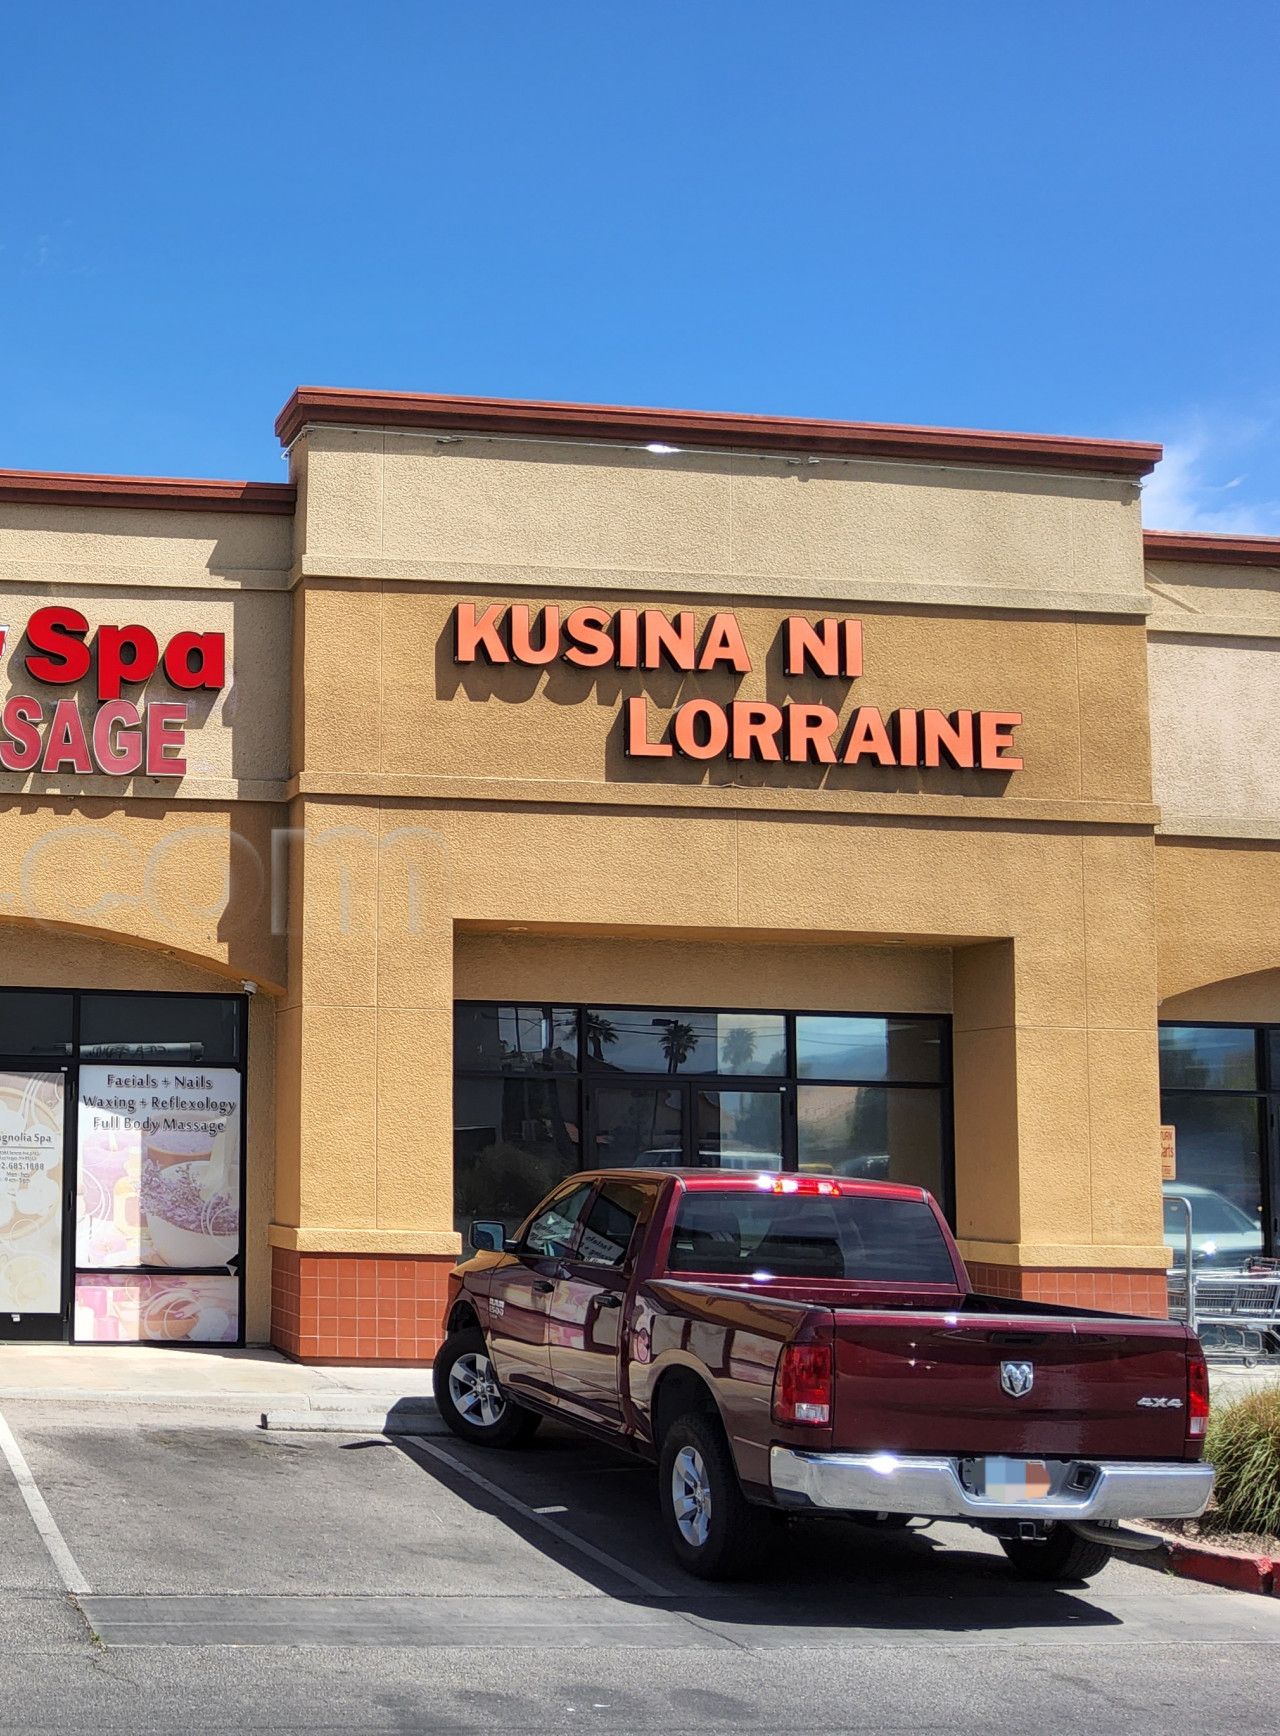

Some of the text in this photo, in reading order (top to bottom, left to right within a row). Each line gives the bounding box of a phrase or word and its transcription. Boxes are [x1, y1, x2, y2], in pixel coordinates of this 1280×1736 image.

[454, 602, 863, 679] KUSINA NI
[25, 606, 225, 700] Spa
[624, 697, 1024, 772] LORRAINE
[107, 1074, 158, 1088] Facials
[174, 1076, 213, 1089] Nails
[83, 1095, 136, 1113] Waxing
[151, 1096, 236, 1116] Reflexology
[93, 1117, 225, 1136] Full Body Massage
[34, 1133, 51, 1144] Spa
